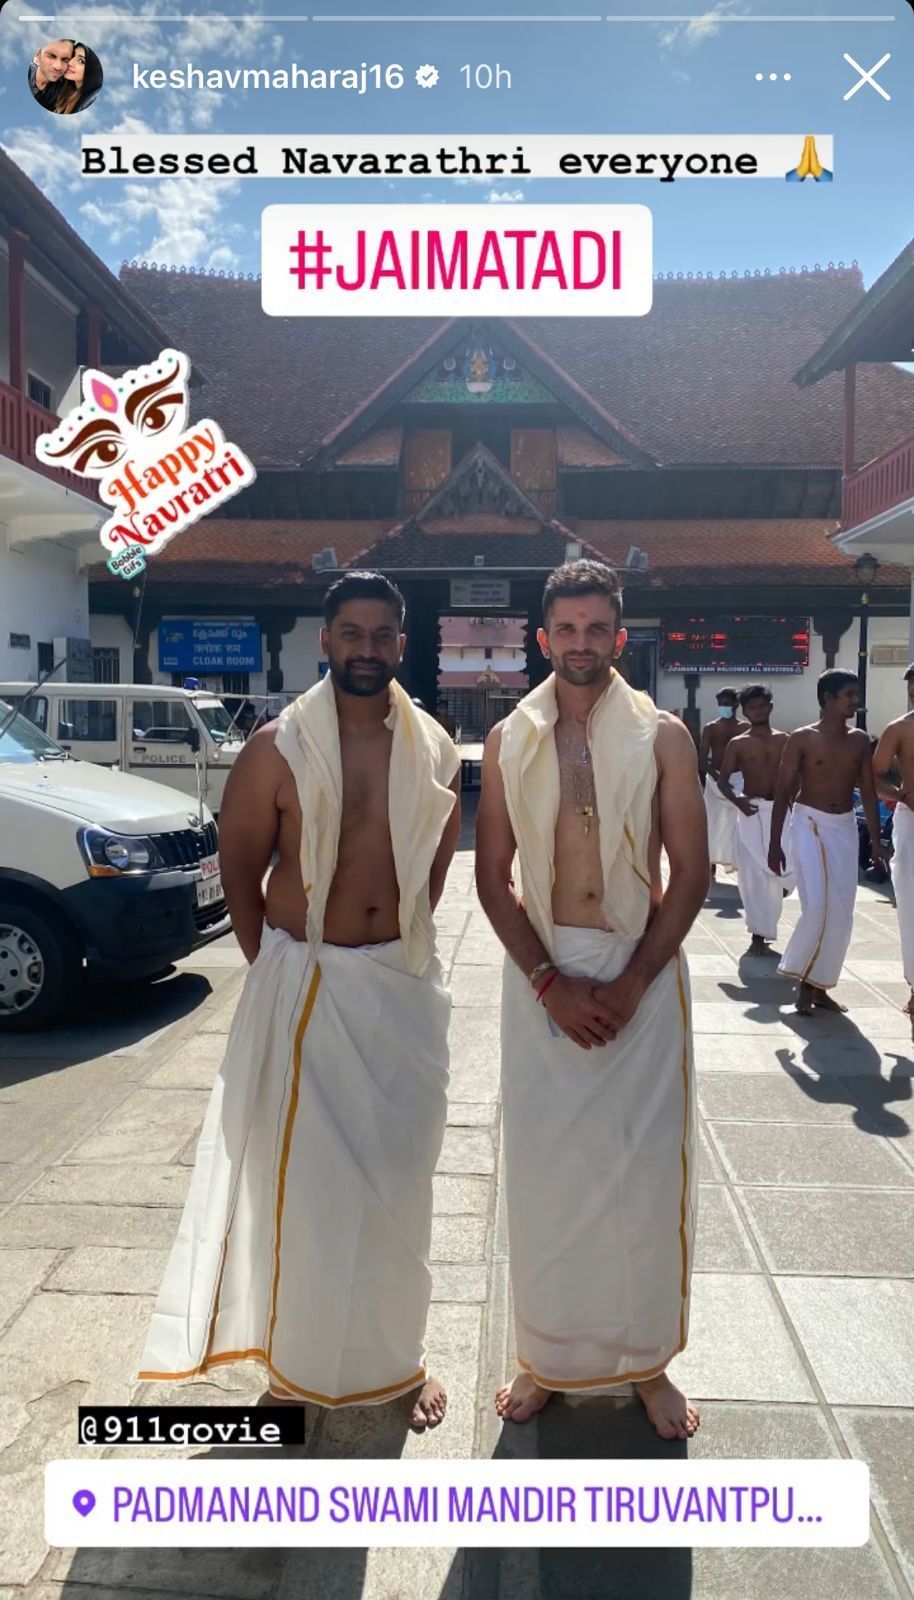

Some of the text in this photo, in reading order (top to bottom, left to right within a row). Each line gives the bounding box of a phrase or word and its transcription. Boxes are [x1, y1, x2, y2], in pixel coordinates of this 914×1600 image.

[192, 656, 255, 666] CLOAK ROOM
[142, 754, 186, 763] POLICE
